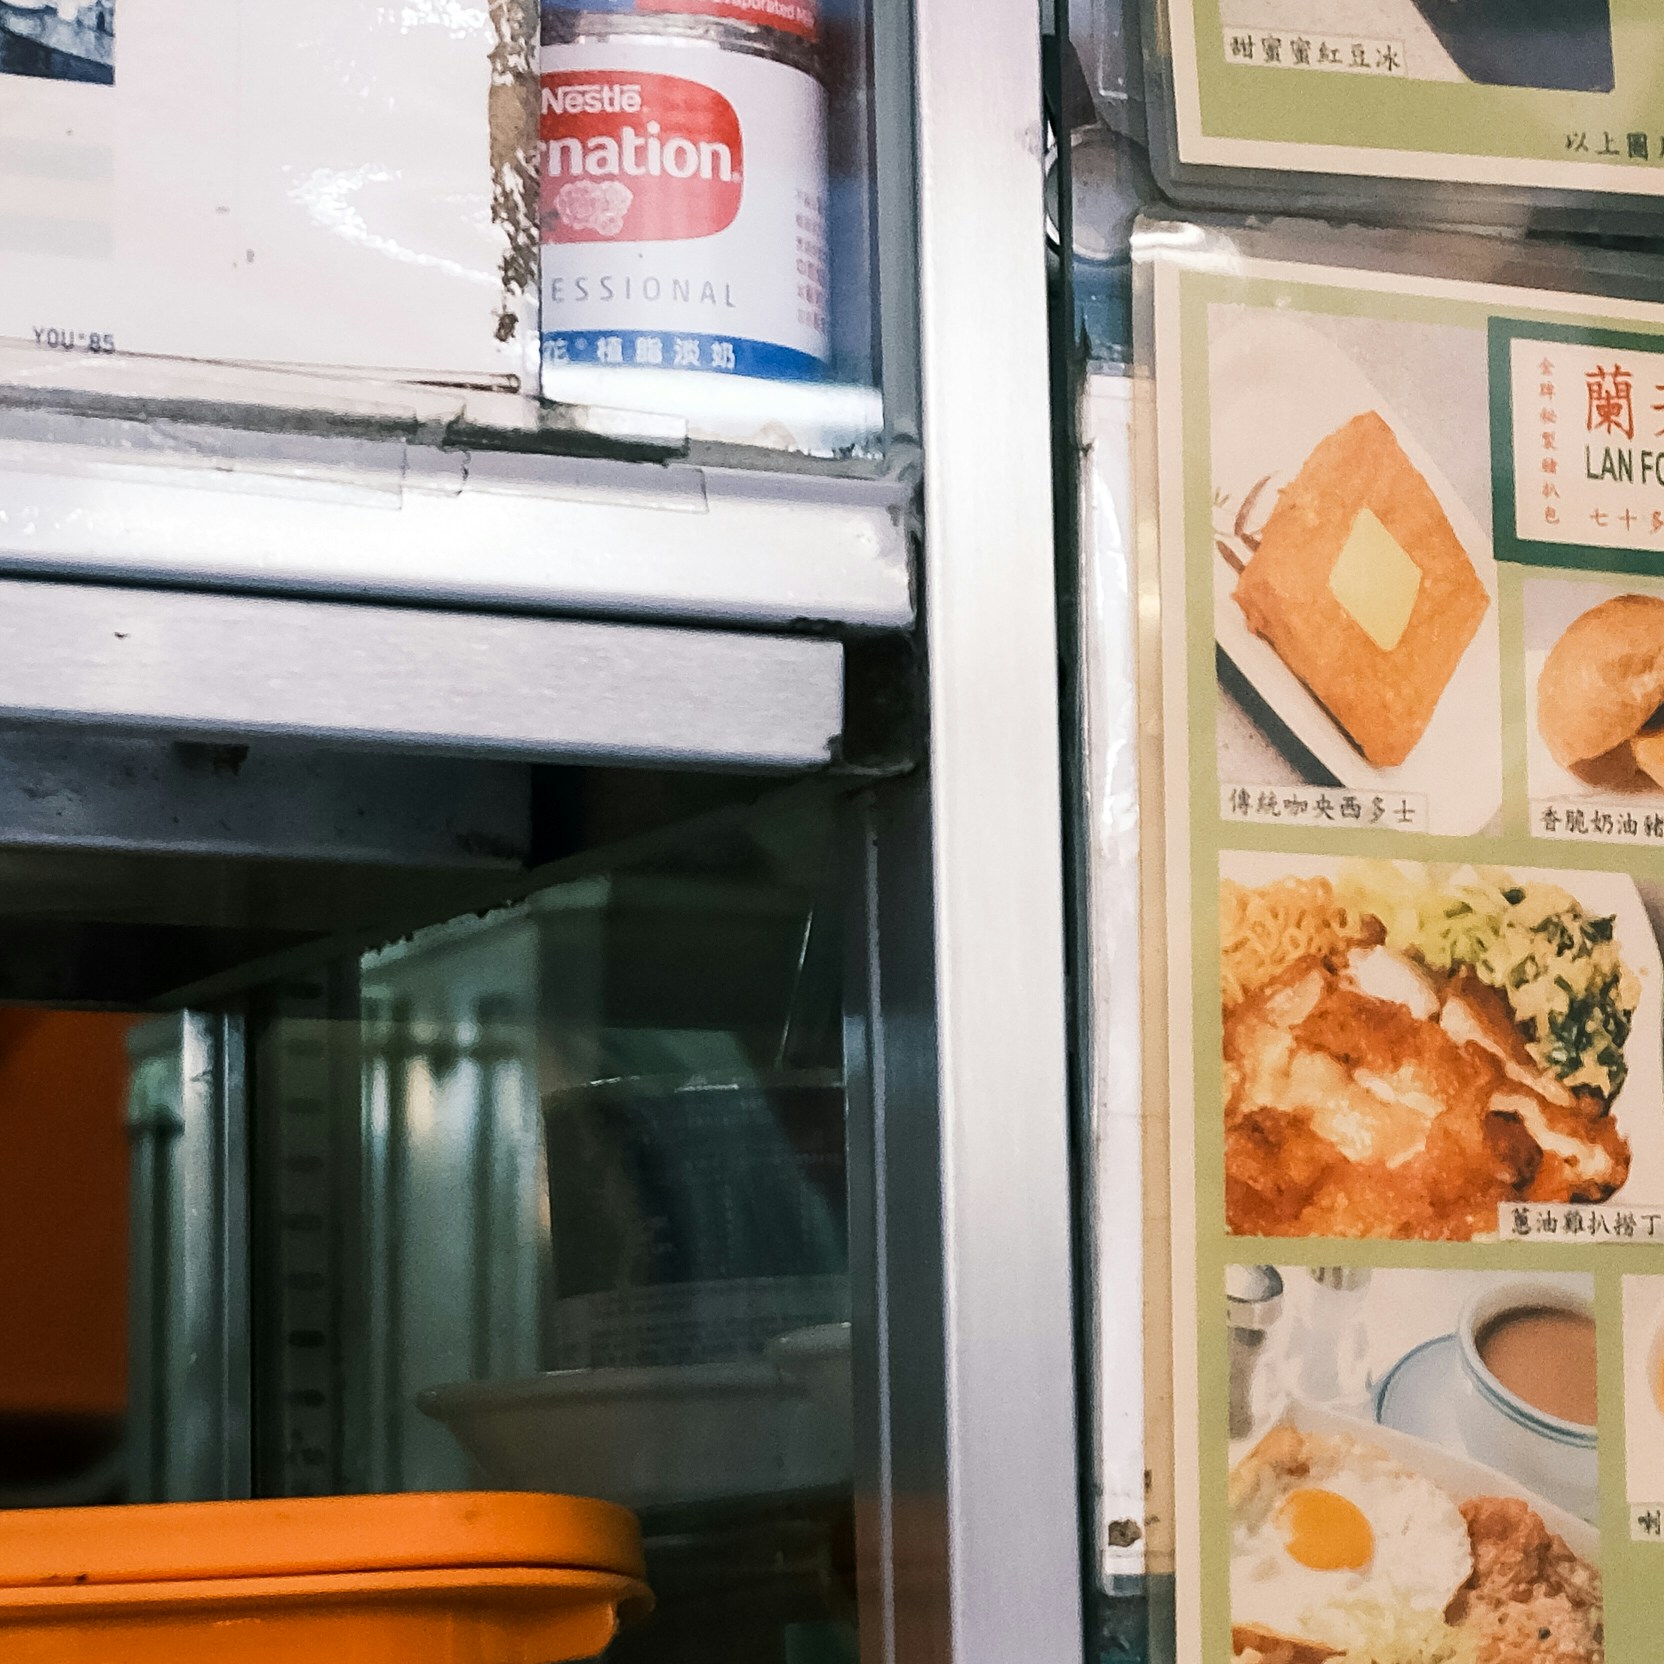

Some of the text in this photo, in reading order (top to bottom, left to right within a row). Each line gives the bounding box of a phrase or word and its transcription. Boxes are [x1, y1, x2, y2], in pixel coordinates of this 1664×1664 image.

[1230, 34, 1401, 72] 甜蜜蜜紅豆冰
[1584, 444, 1634, 483] LAN
[1229, 787, 1416, 824] 傳統咖央西多士
